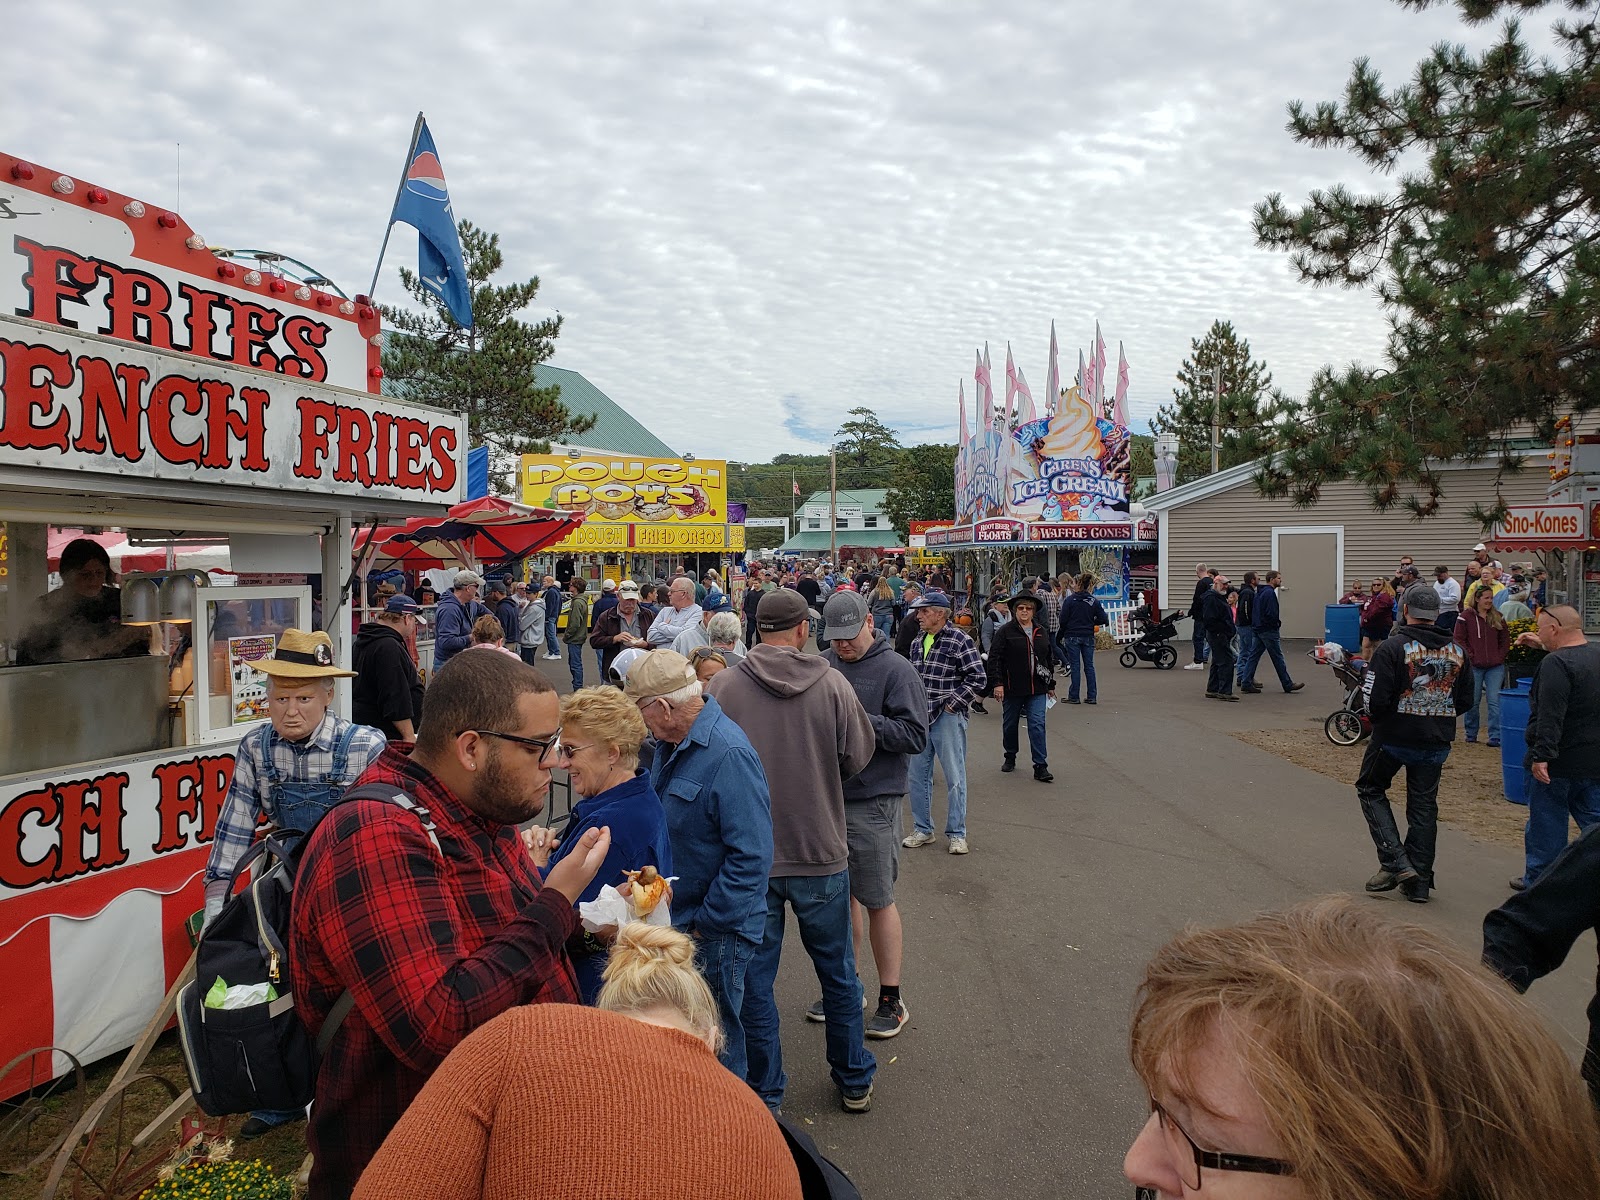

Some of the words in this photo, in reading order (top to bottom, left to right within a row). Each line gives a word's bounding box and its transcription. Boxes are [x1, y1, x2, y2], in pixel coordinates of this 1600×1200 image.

[14, 234, 333, 383] FRIES
[0, 338, 270, 473] ENCH
[294, 396, 458, 494] FRIES
[528, 461, 721, 489] DOUGH
[557, 482, 694, 507] BOYS
[1012, 479, 1051, 506] ICE
[1049, 475, 1127, 504] CREAM
[980, 523, 995, 531] ROOT
[1040, 527, 1088, 539] WAFFLE
[1090, 526, 1131, 539] CONES
[1504, 511, 1578, 534] Sno-Kones
[577, 527, 623, 545] DOUGH
[639, 528, 676, 545] FRIED
[677, 527, 723, 545] OREOS
[978, 530, 1012, 541] FLOATS
[152, 753, 237, 855] FR
